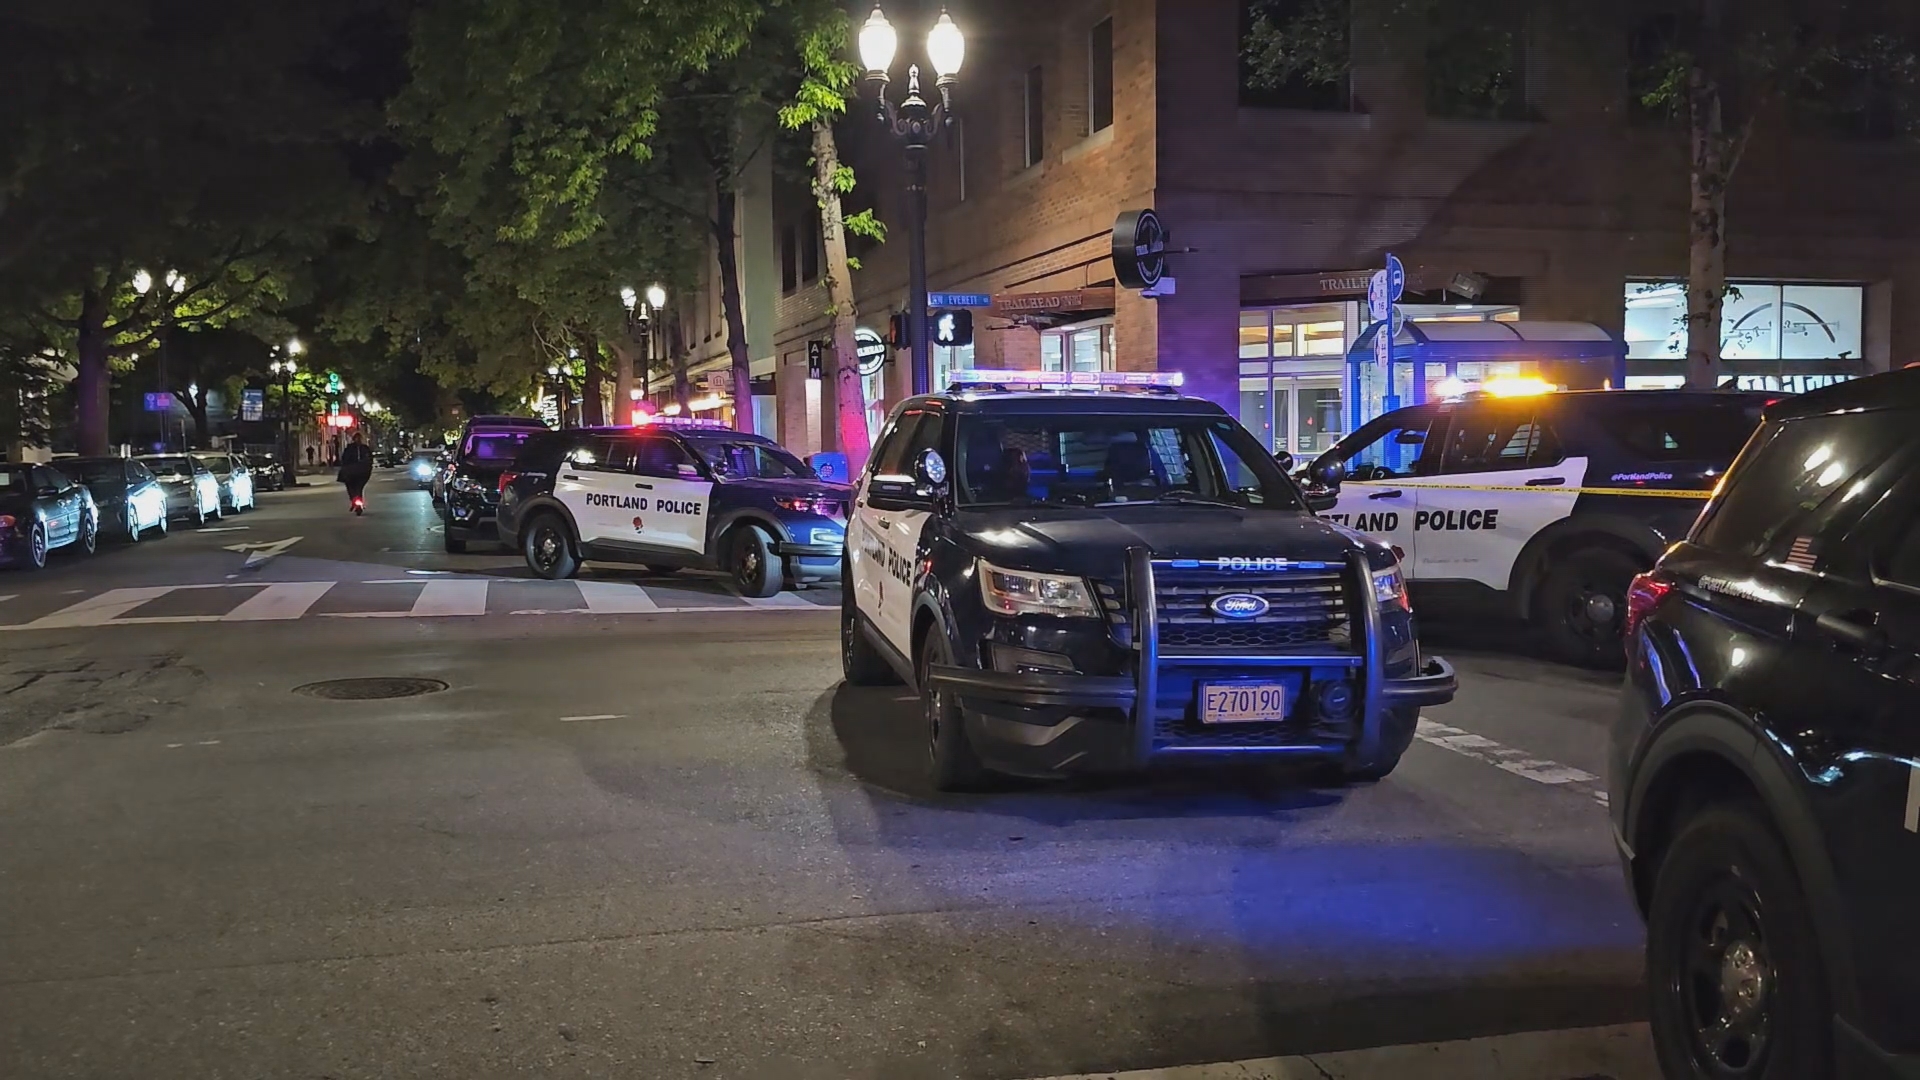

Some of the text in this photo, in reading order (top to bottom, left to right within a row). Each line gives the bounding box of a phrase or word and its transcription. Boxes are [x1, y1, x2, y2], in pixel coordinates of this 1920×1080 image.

[948, 295, 978, 305] EVERETT
[997, 296, 1061, 311] TRAILHEAD
[1378, 302, 1385, 310] 16
[810, 343, 821, 379] ATM
[586, 493, 702, 516] PORTLAND POLICE
[1319, 509, 1499, 532] TLAND POLICE
[888, 546, 912, 587] POLICE
[1217, 557, 1288, 571] POLICE
[1224, 597, 1257, 612] Ford
[1207, 689, 1280, 713] E270190
